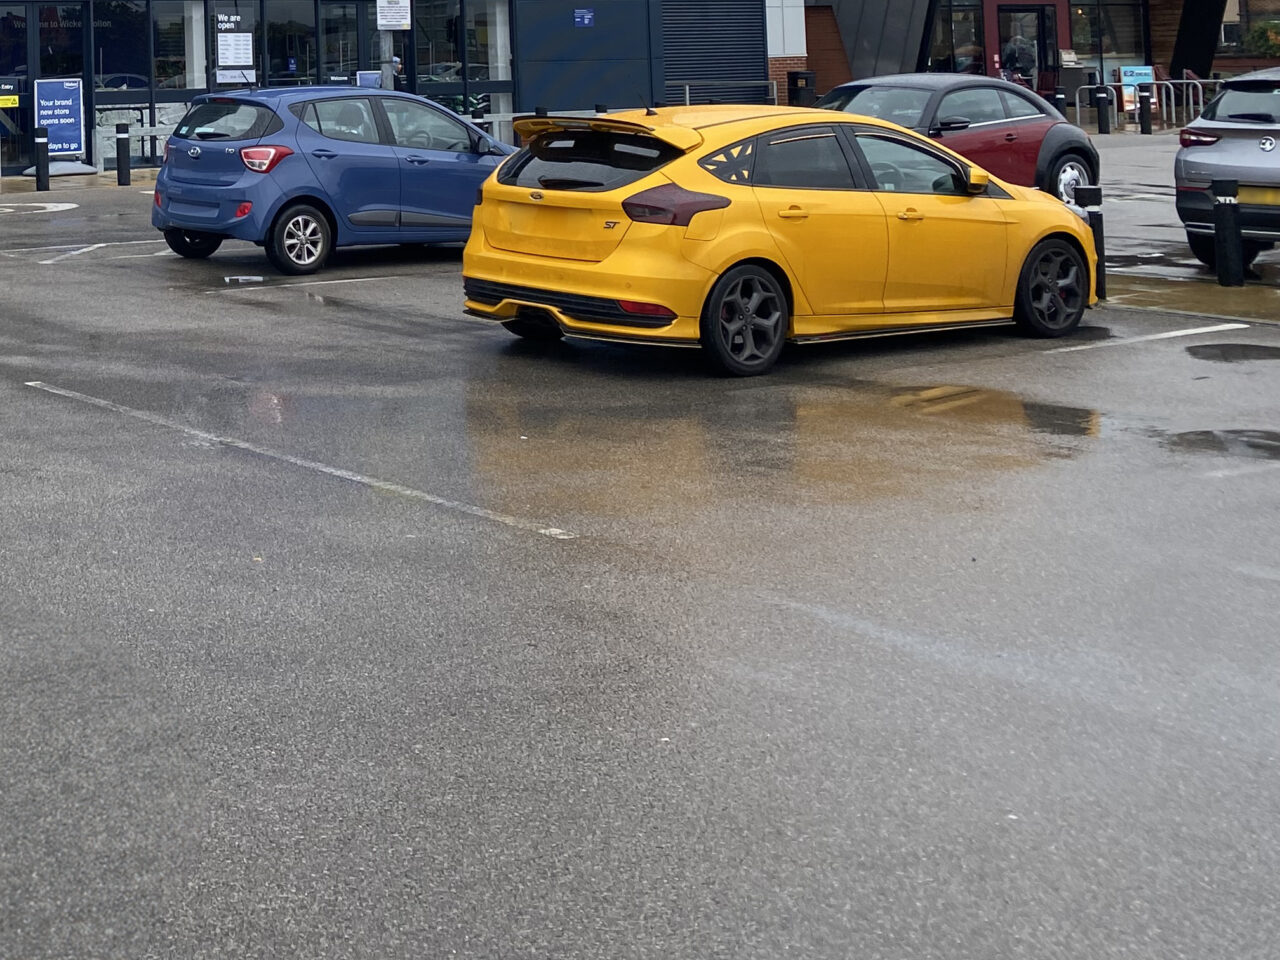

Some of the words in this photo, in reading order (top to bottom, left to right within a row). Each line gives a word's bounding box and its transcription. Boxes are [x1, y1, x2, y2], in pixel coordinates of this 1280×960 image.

[59, 18, 82, 27] Wicke
[93, 19, 112, 28] olton
[217, 22, 235, 30] open
[54, 98, 72, 106] brand
[48, 142, 62, 150] days
[63, 141, 69, 149] to
[603, 221, 620, 229] ST
